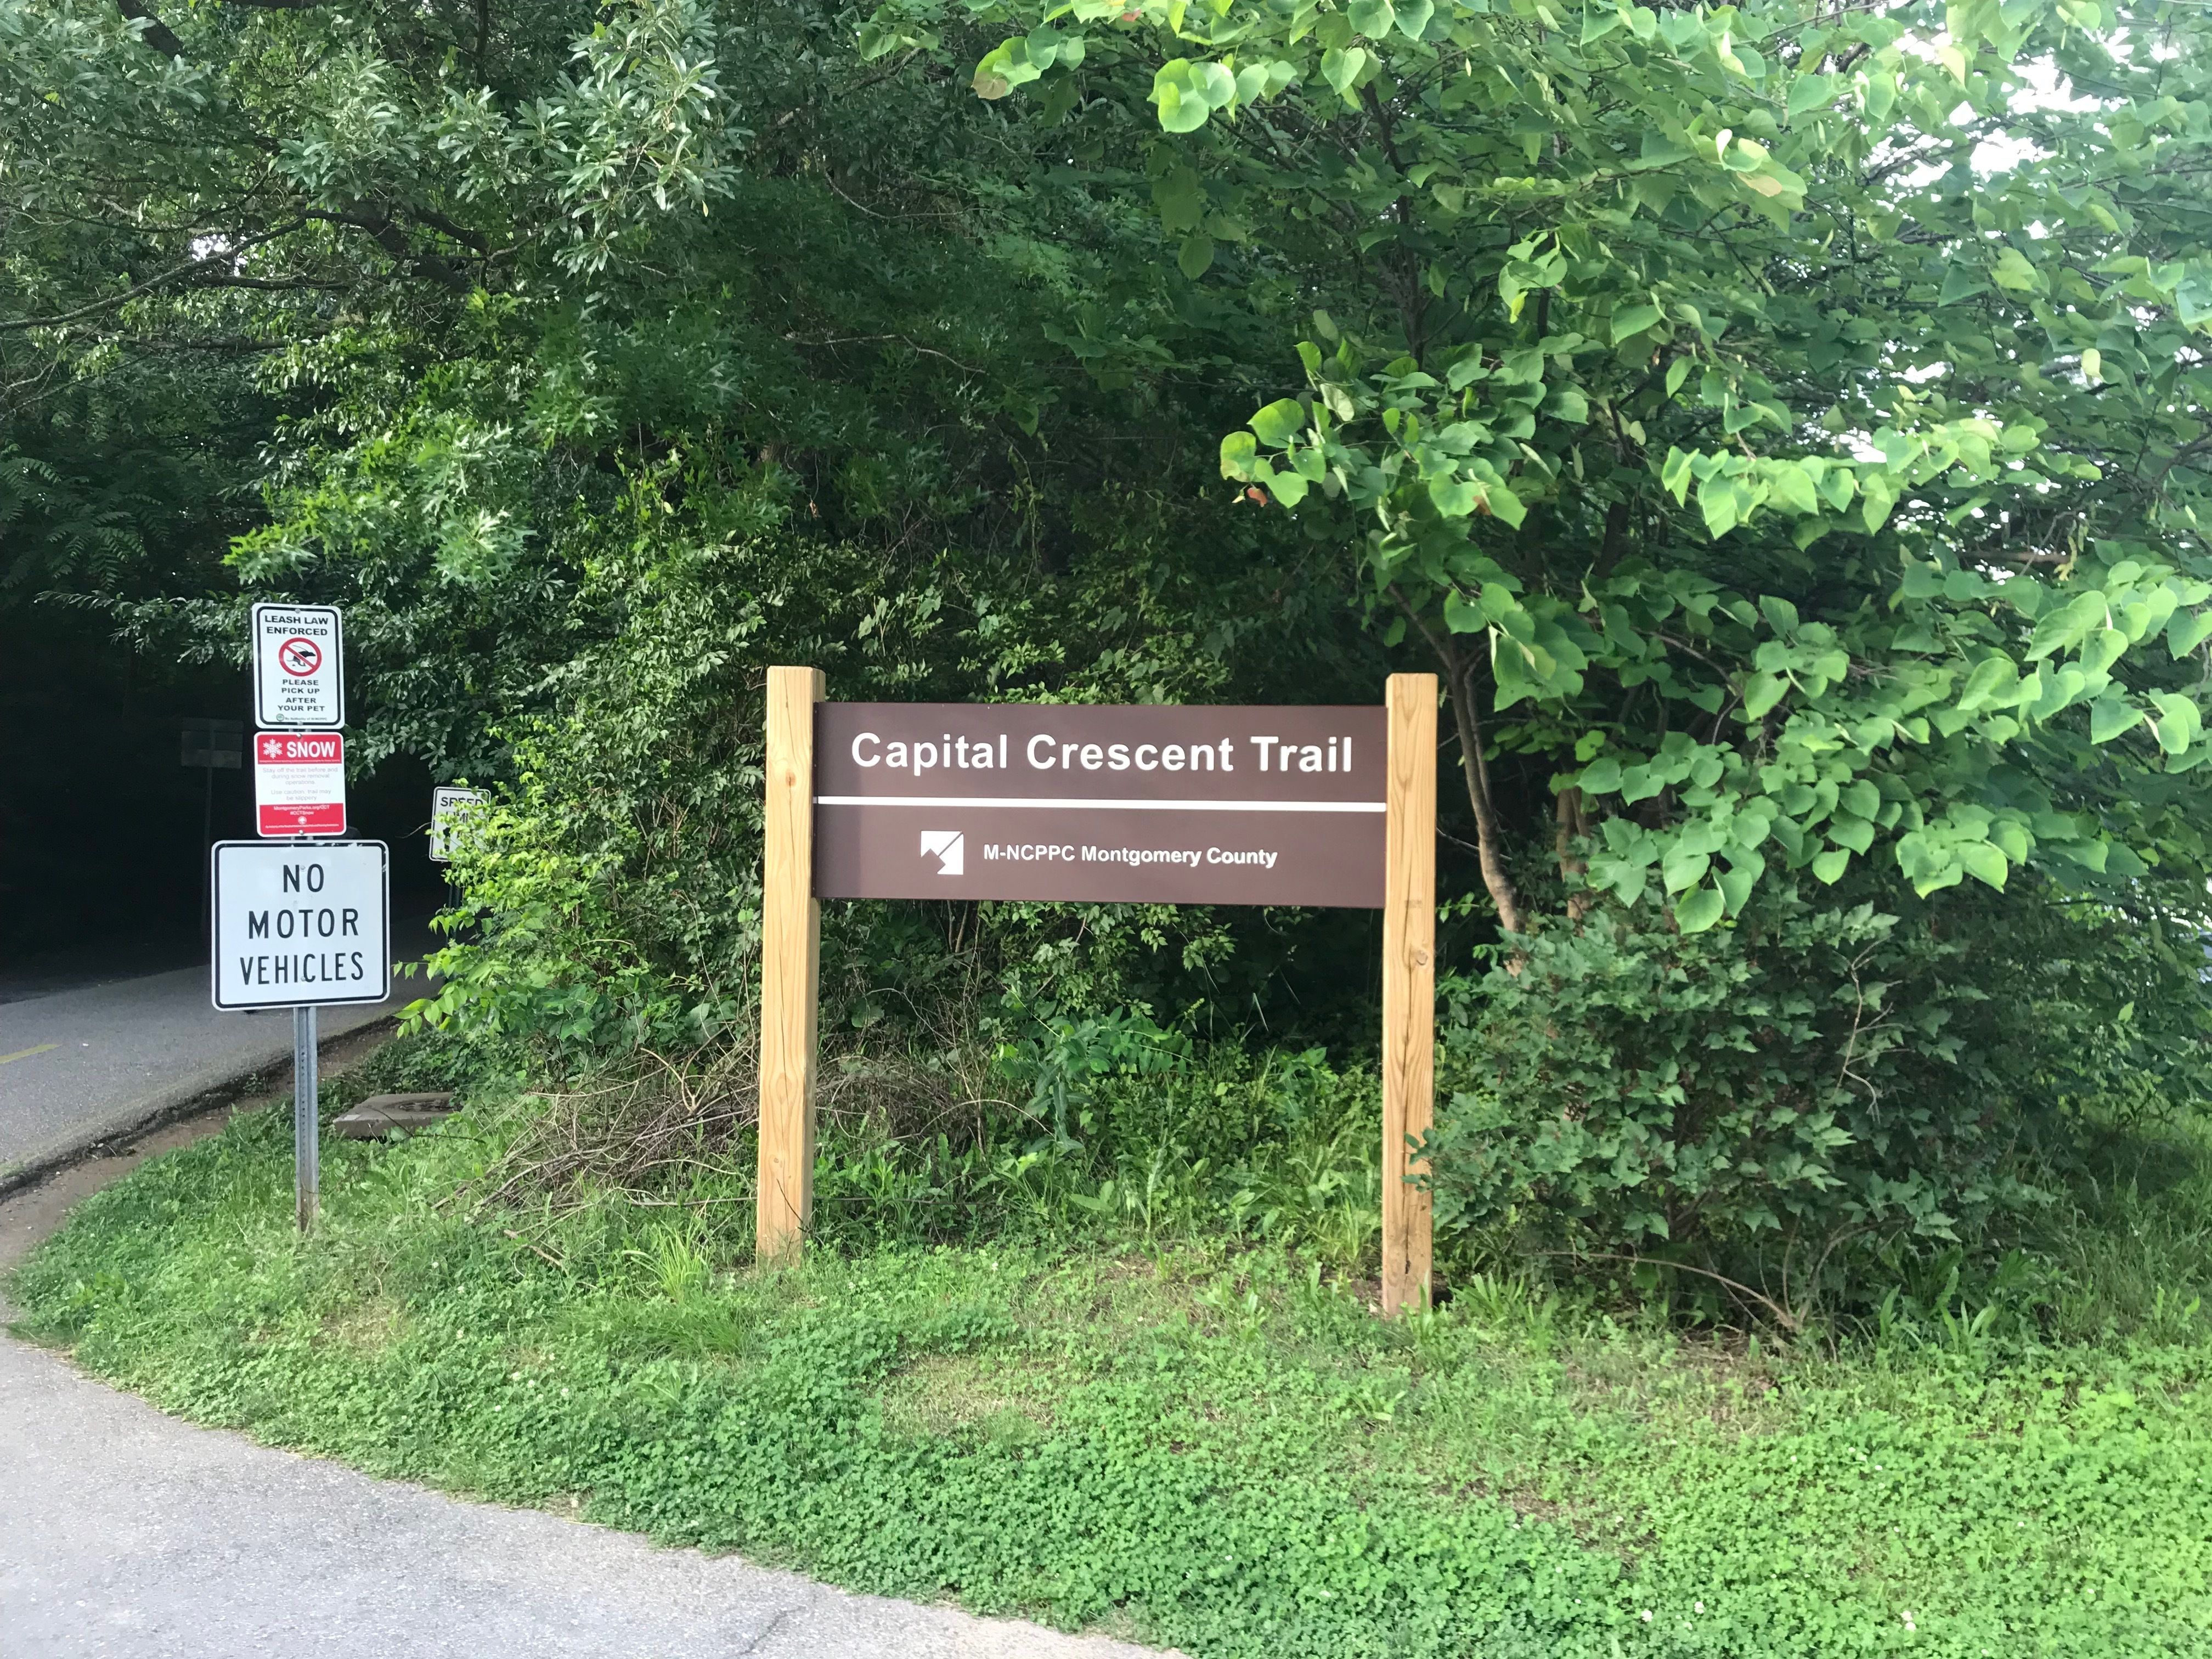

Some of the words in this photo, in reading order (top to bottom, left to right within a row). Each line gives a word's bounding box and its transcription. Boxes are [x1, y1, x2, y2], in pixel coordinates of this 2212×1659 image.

[264, 615, 301, 624] LEASH
[304, 617, 329, 625] LAW
[267, 627, 328, 636] ENFORCED
[286, 741, 335, 758] SNOW
[851, 732, 1007, 776] Capital
[1027, 734, 1234, 772] Crescent
[1250, 736, 1352, 772] Trail
[984, 844, 1075, 861] M-NCPPC
[1081, 846, 1202, 867] Montgomery
[1207, 847, 1278, 868] County
[283, 864, 324, 893] NO
[249, 909, 359, 939] MOTOR
[240, 952, 364, 985] VEHICLES
